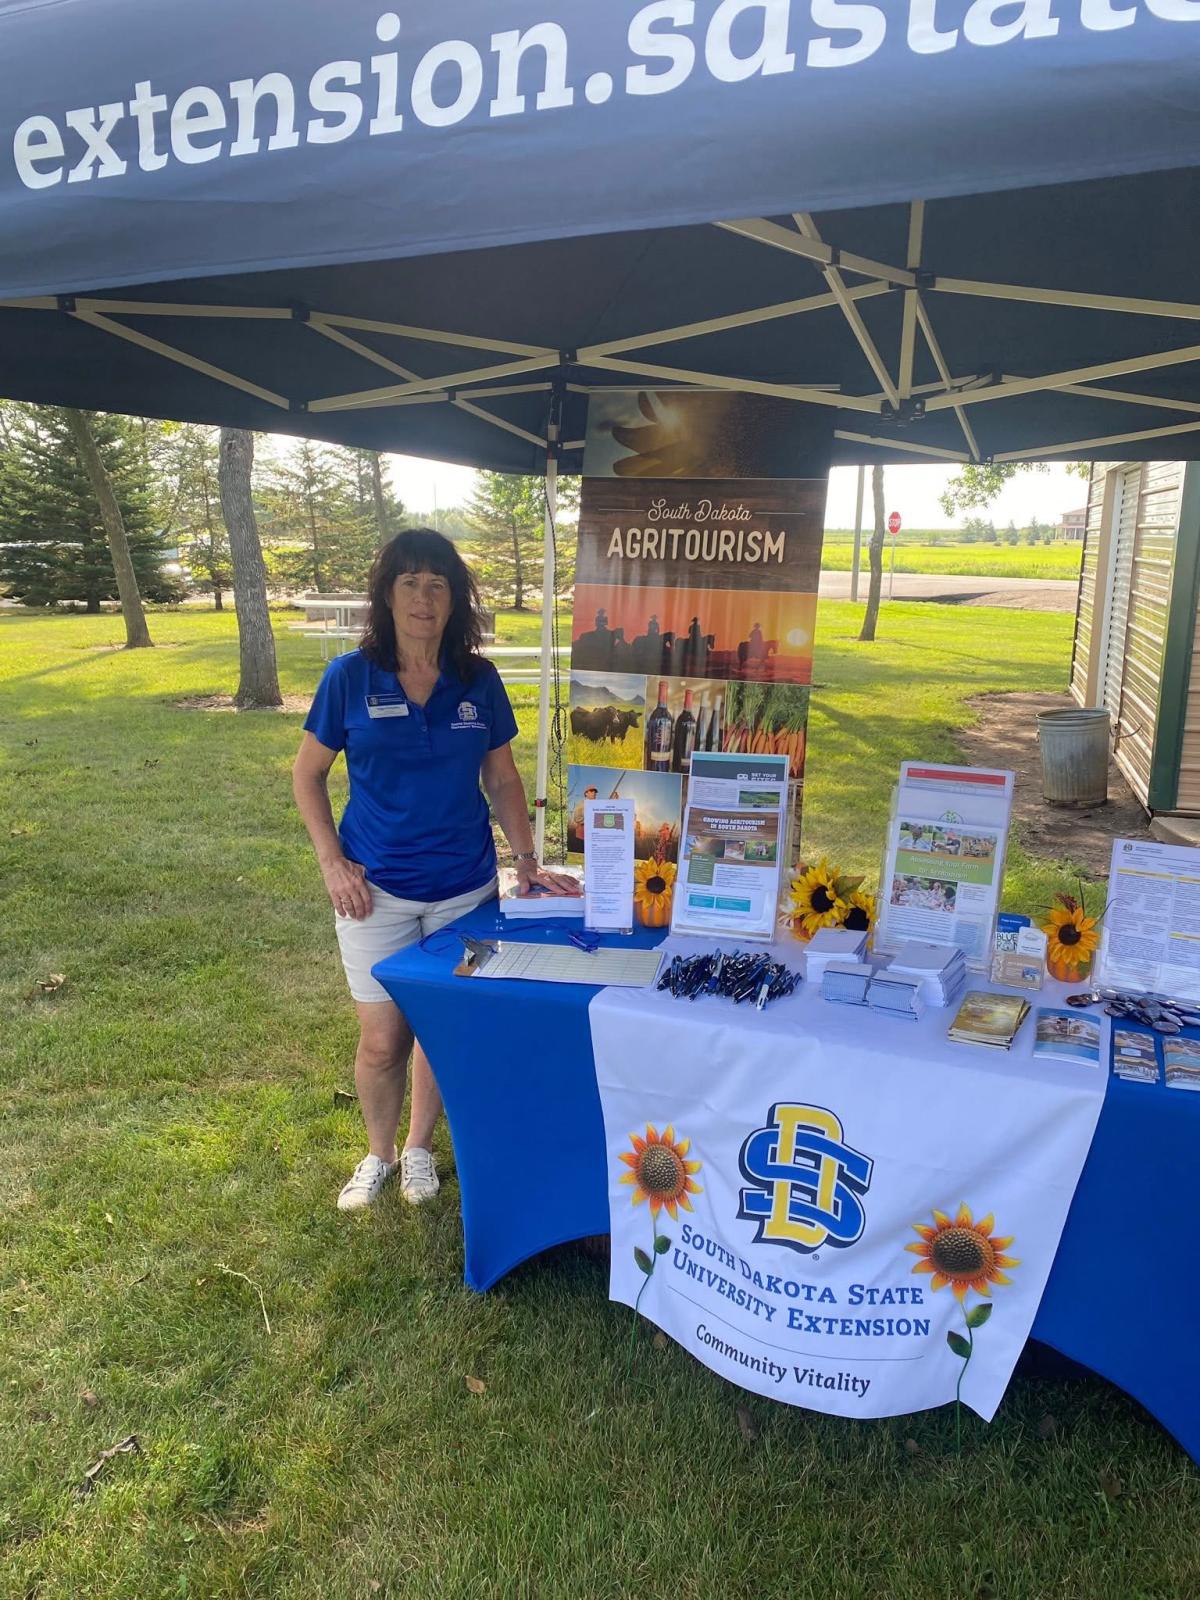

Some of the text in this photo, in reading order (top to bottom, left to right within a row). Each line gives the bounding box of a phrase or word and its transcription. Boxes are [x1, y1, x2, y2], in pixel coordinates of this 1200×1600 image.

[14, 0, 1200, 190] extension.sds
[607, 527, 786, 564] AGRITOURISM
[648, 498, 752, 522] South Dakota
[997, 932, 1017, 942] BLUE
[673, 1248, 931, 1337] UNIVERSITY EXTENSION
[681, 1223, 924, 1305] SOUTH DAKOTA STATE
[696, 1324, 870, 1398] Community Vitality
